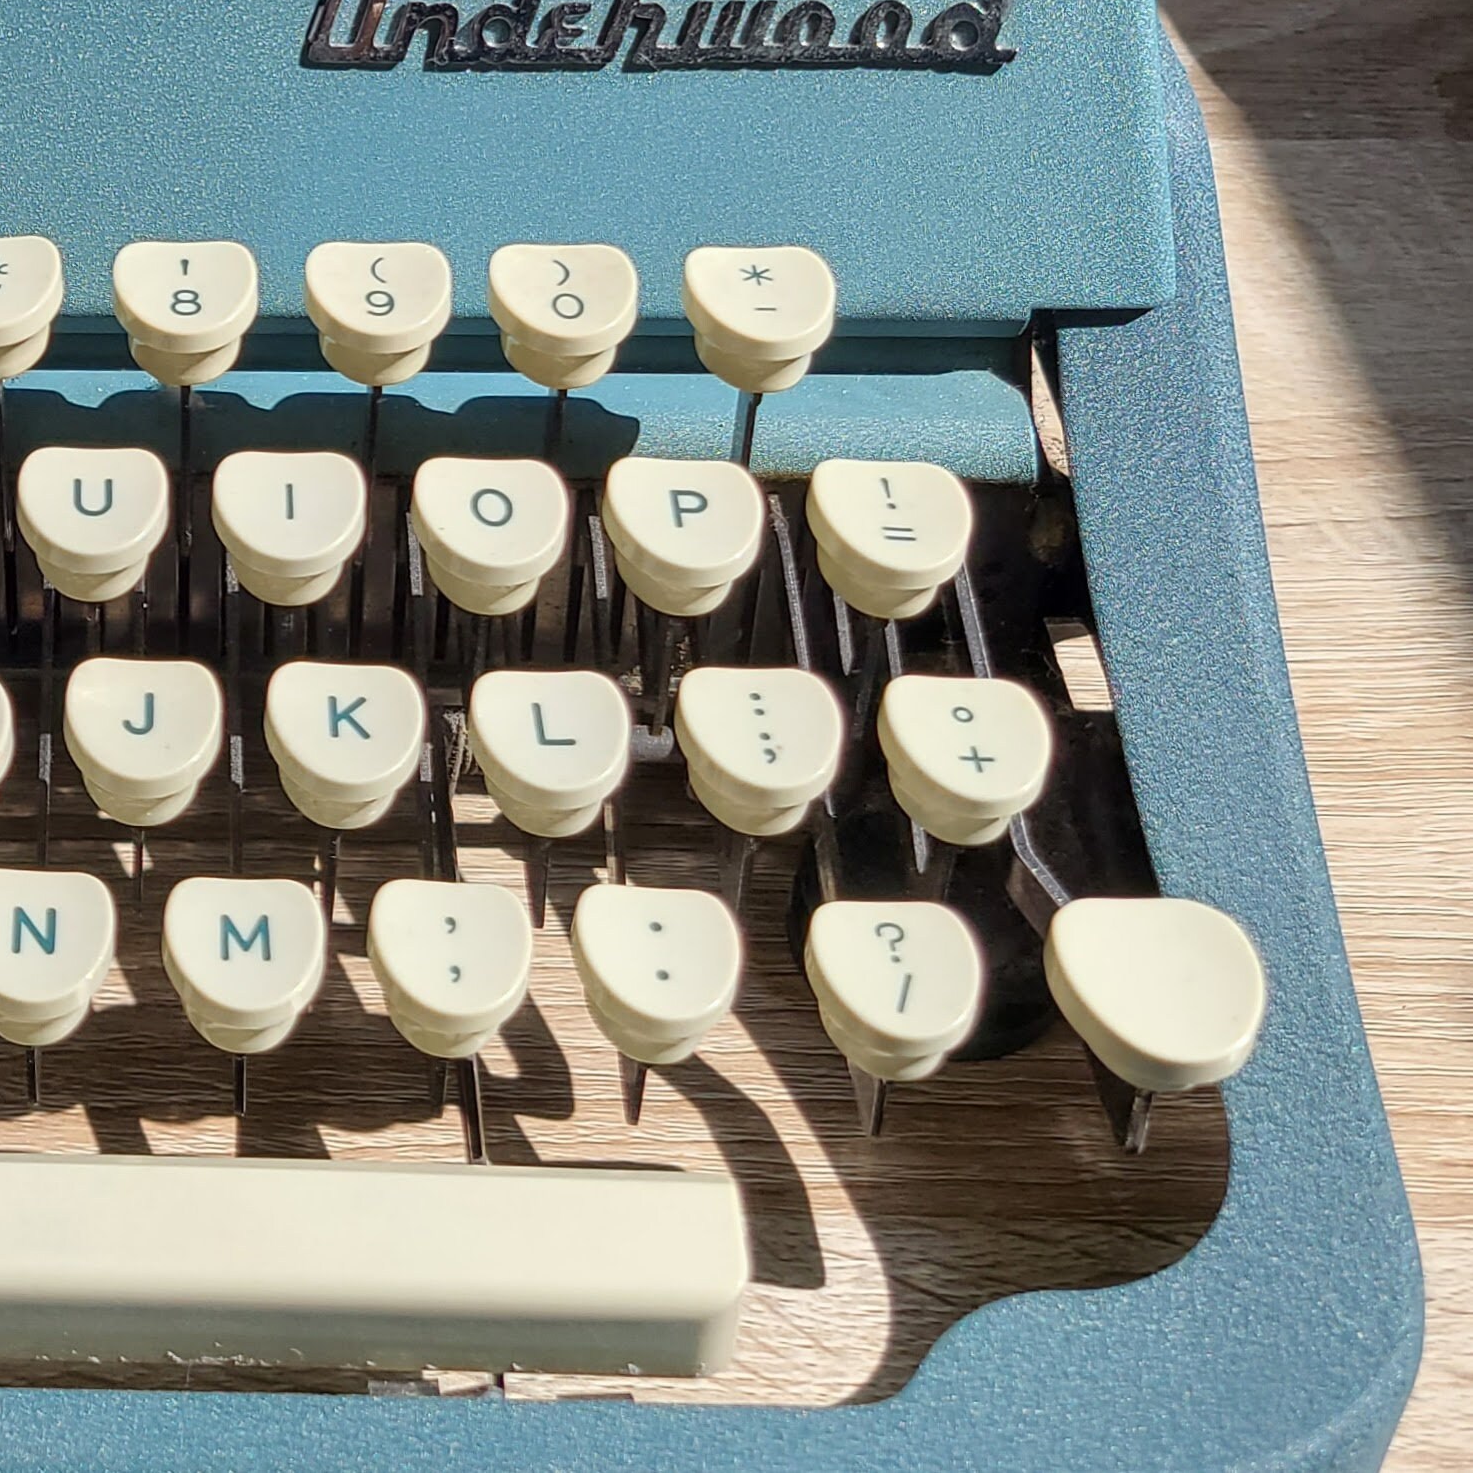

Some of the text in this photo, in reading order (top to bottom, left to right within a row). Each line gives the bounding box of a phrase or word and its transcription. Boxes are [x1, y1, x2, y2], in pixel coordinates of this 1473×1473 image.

[168, 288, 204, 318] 8
[363, 289, 397, 318] 9
[72, 476, 115, 518] U
[469, 487, 515, 529] O
[668, 488, 710, 530] P
[121, 691, 156, 737] J
[326, 694, 373, 741] K
[530, 701, 578, 748] L
[10, 905, 58, 957] N
[219, 913, 273, 963] M
[873, 921, 907, 965] ?
